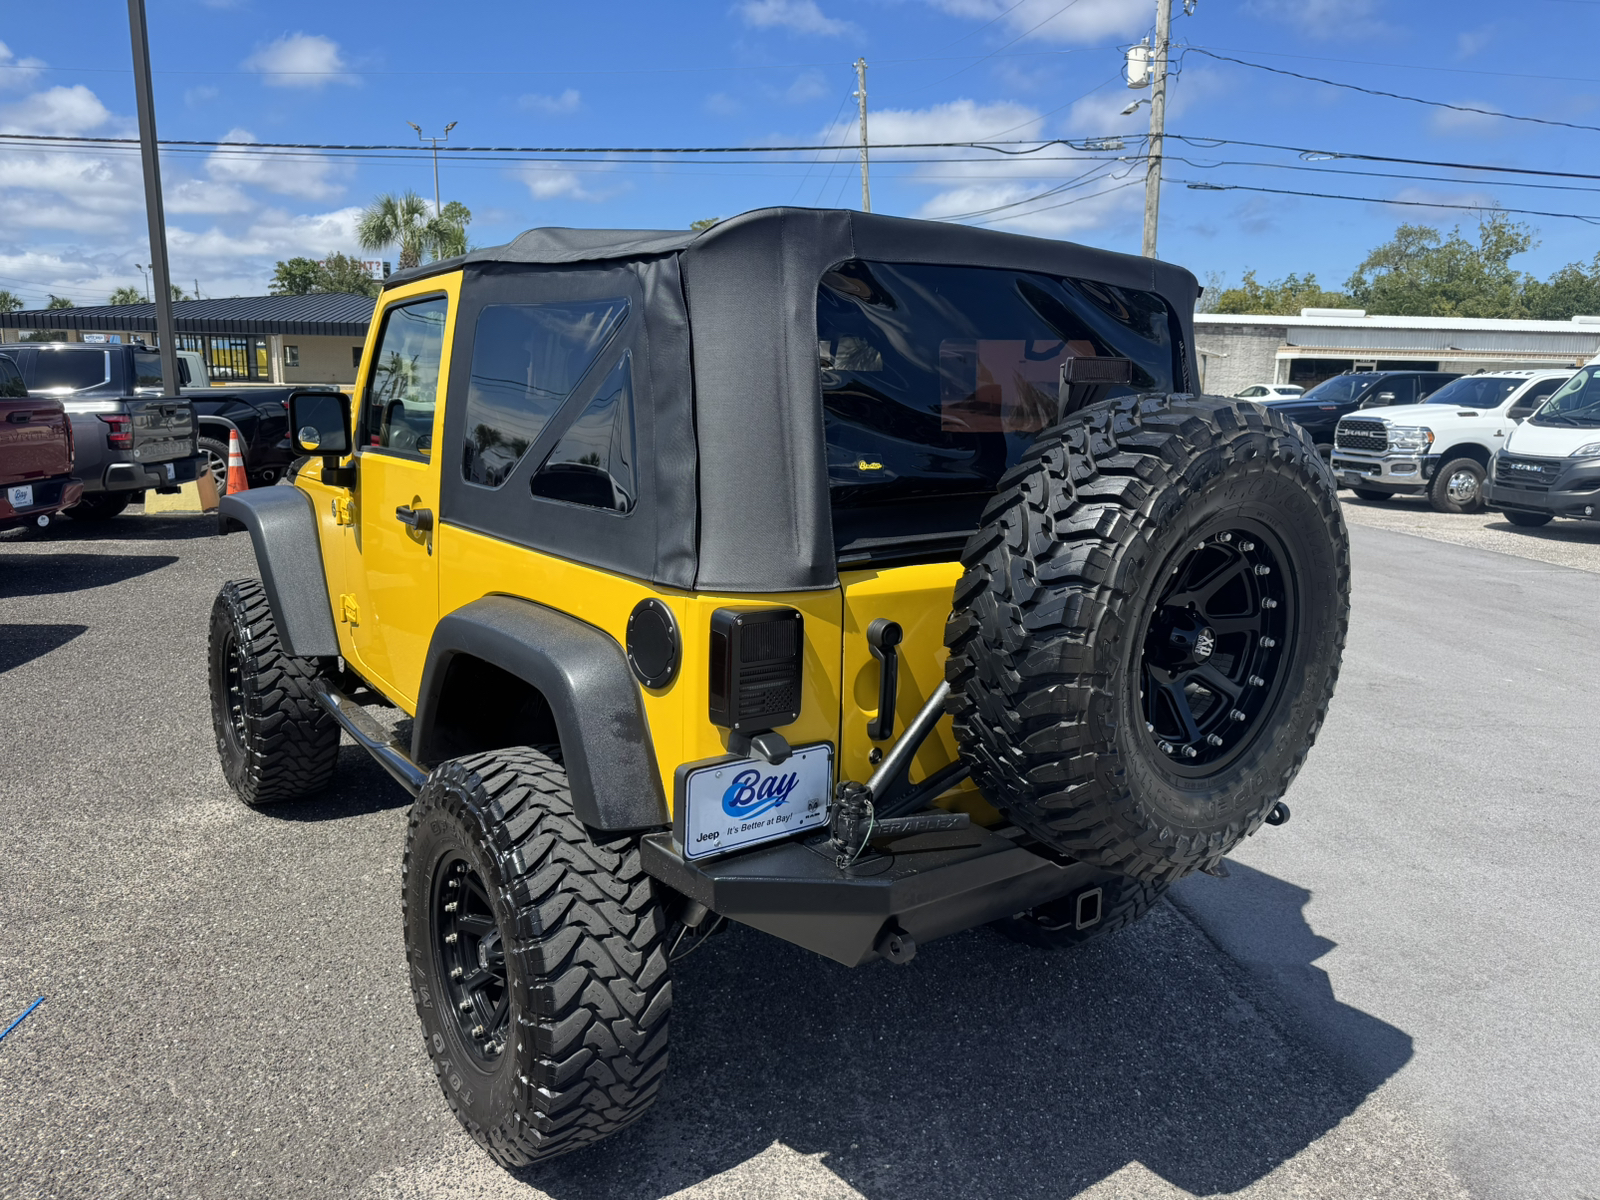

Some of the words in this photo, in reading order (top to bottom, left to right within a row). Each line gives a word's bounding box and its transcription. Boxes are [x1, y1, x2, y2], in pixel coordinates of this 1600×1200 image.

[1511, 463, 1543, 472] RAM
[1228, 477, 1308, 516] TOYO
[728, 769, 800, 808] Bay
[726, 825, 739, 836] It's
[740, 820, 765, 832] Better
[766, 818, 774, 826] at
[775, 813, 793, 826] Bay!
[867, 817, 960, 834] TERAFLEX
[696, 830, 720, 843] Jeep
[432, 1031, 475, 1107] TOYO
